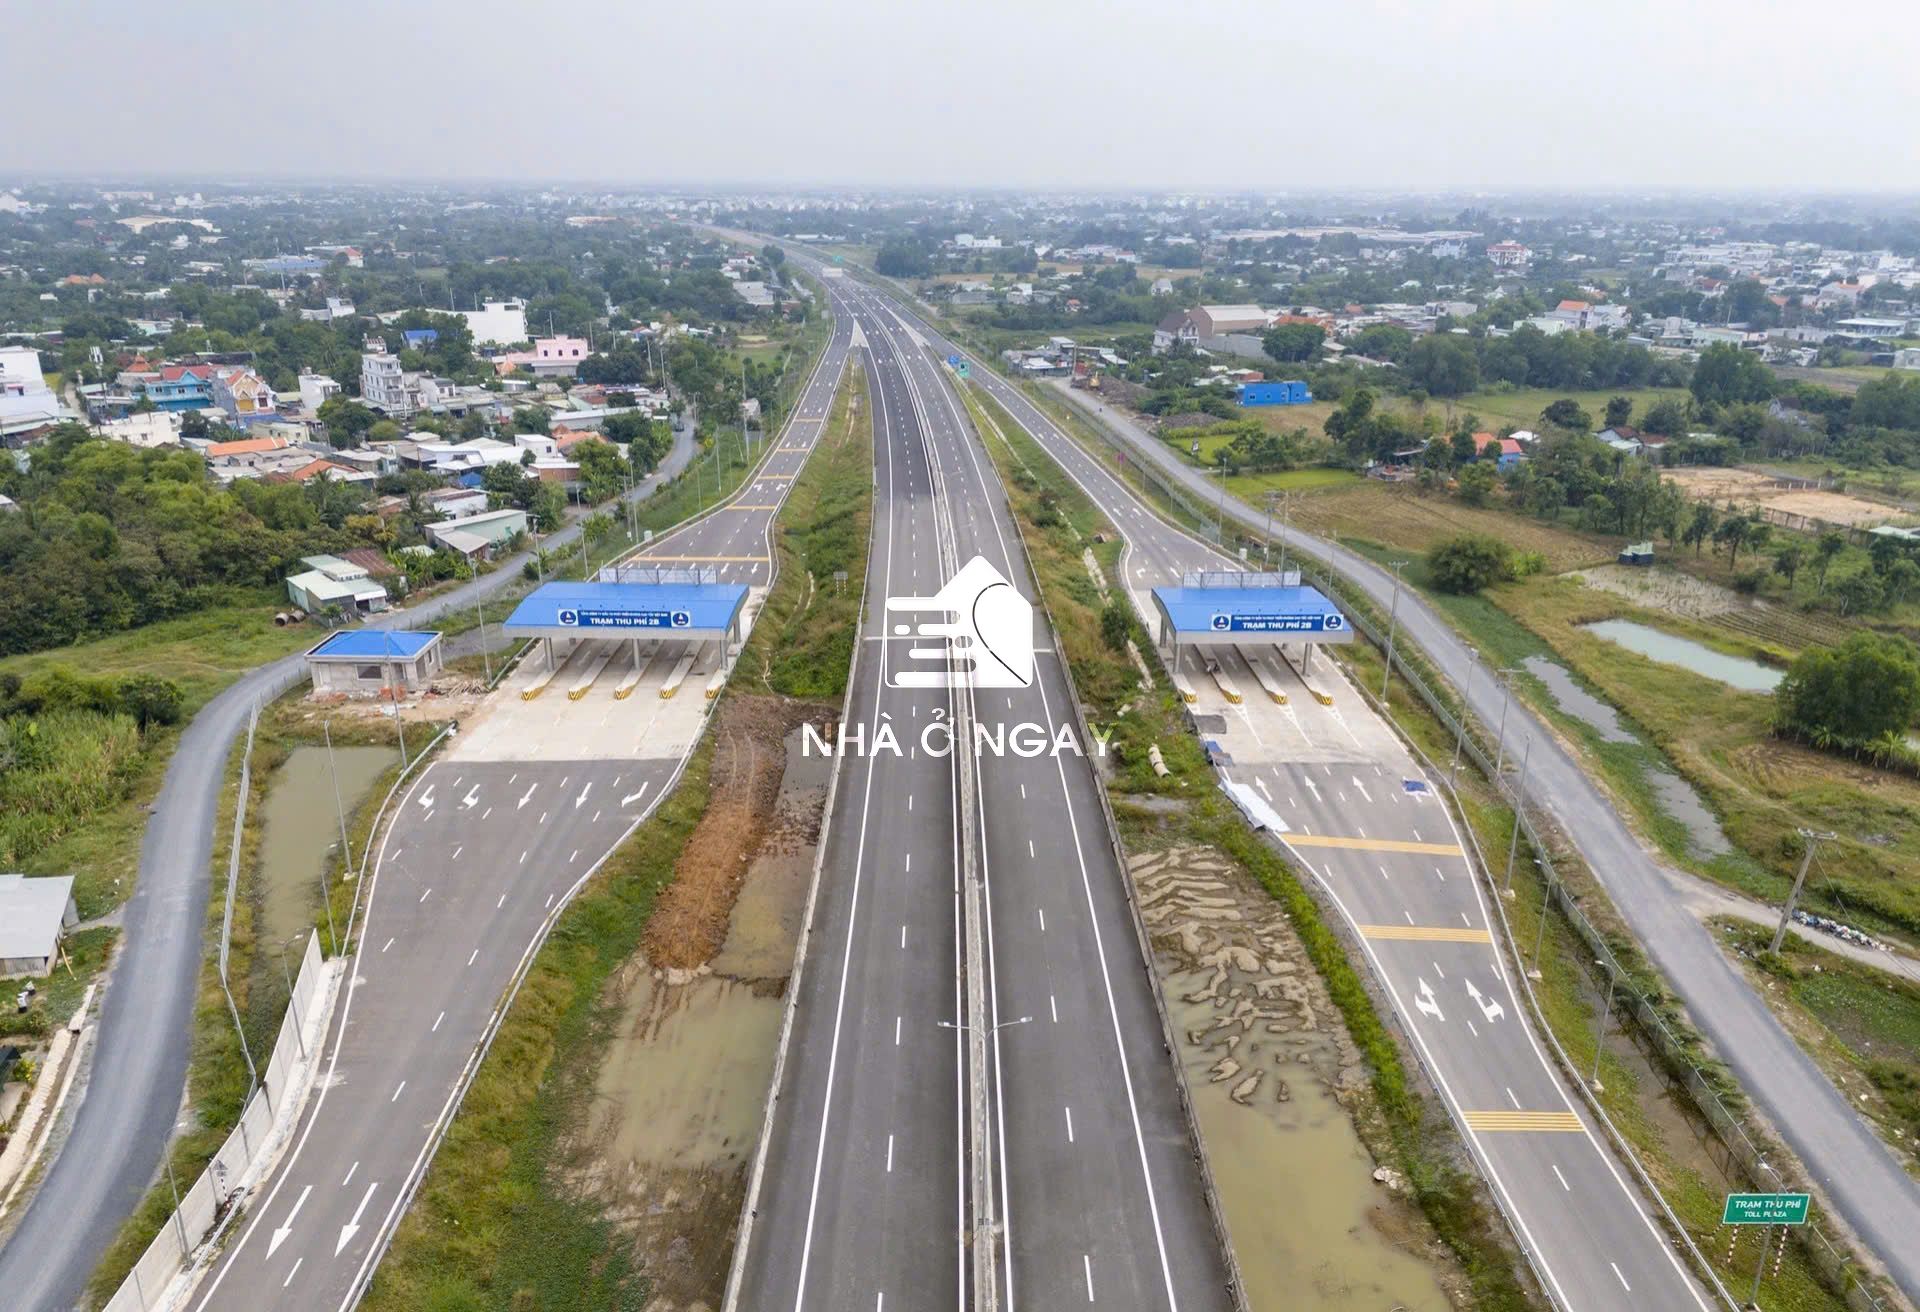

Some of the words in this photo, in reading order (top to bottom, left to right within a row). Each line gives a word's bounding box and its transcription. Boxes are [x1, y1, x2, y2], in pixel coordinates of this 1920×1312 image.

[634, 617, 648, 625] PHÍ
[1243, 622, 1266, 630] TRẠM
[1286, 620, 1300, 628] PHÍ
[1785, 1199, 1802, 1208] PHÍ
